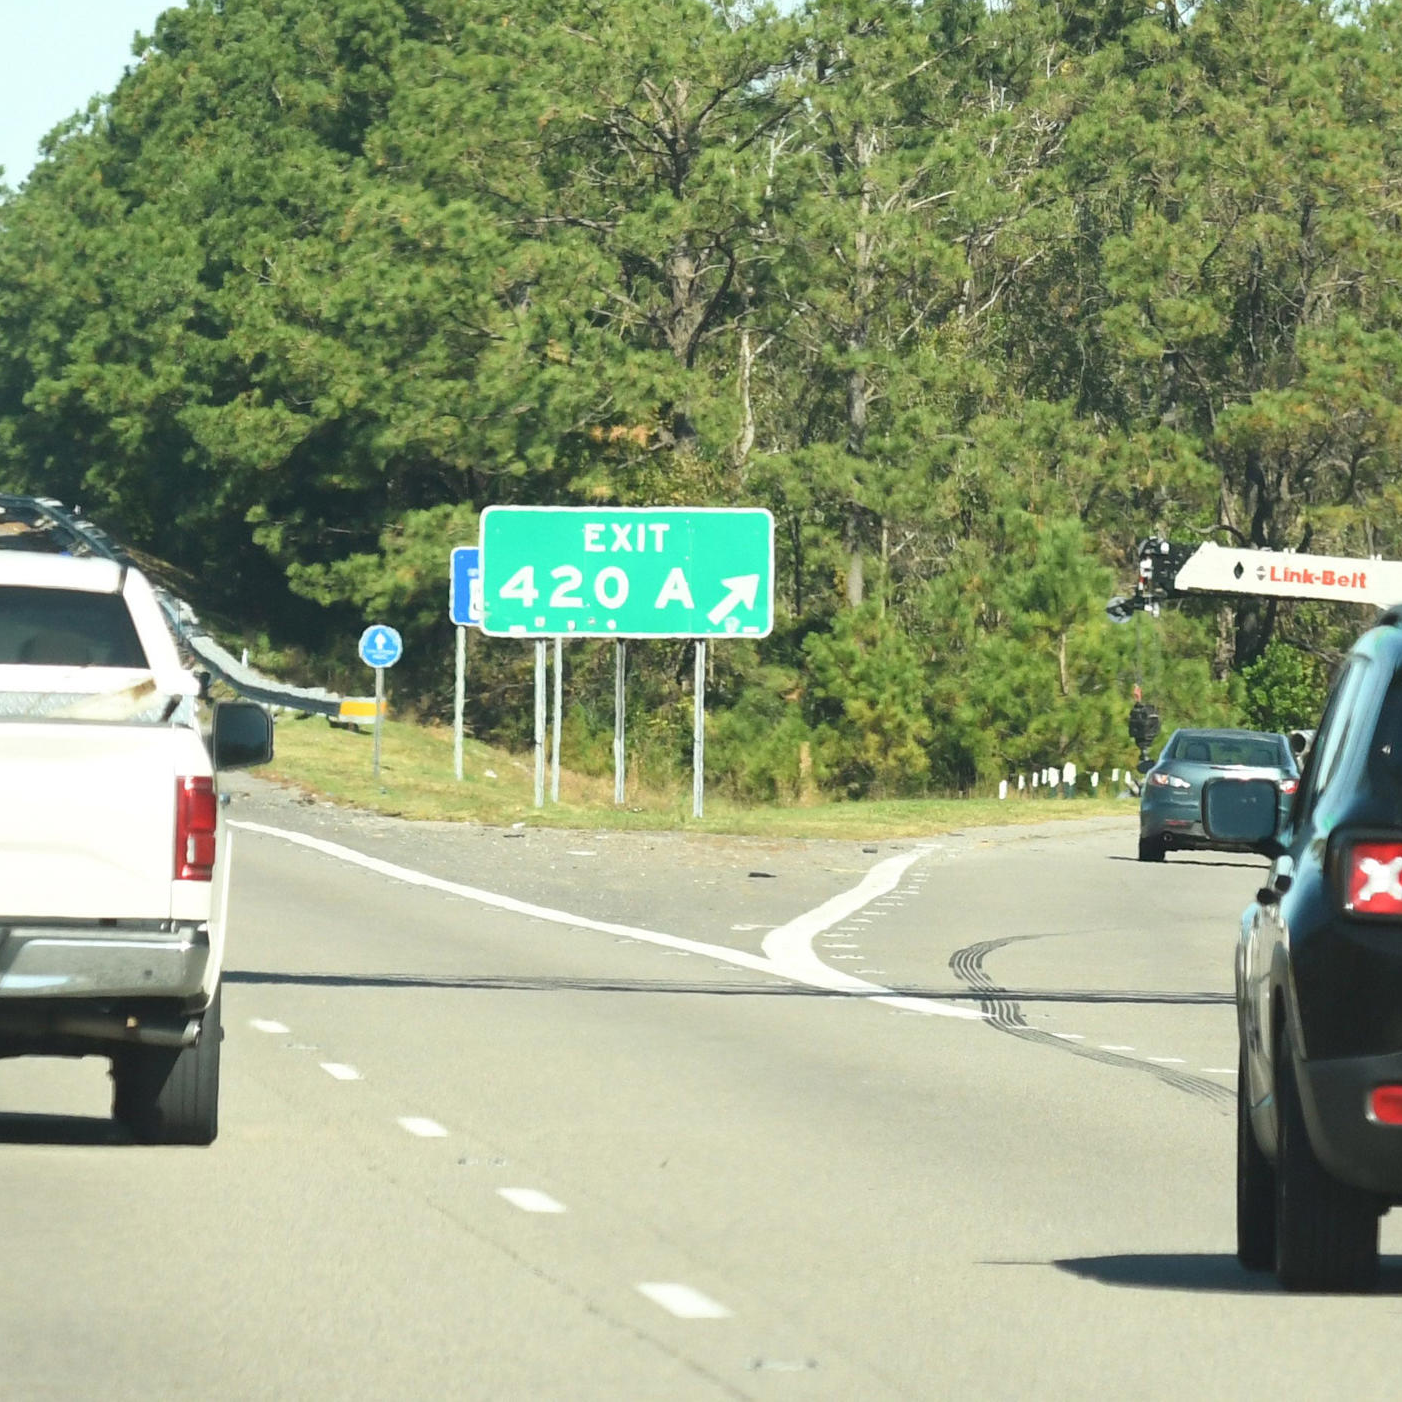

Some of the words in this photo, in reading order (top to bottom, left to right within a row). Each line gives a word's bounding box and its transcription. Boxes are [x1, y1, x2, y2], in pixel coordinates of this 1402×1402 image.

[584, 524, 669, 552] EXIT
[500, 565, 629, 609] 420
[655, 568, 694, 608] A
[1269, 565, 1367, 589] Link-Belt
